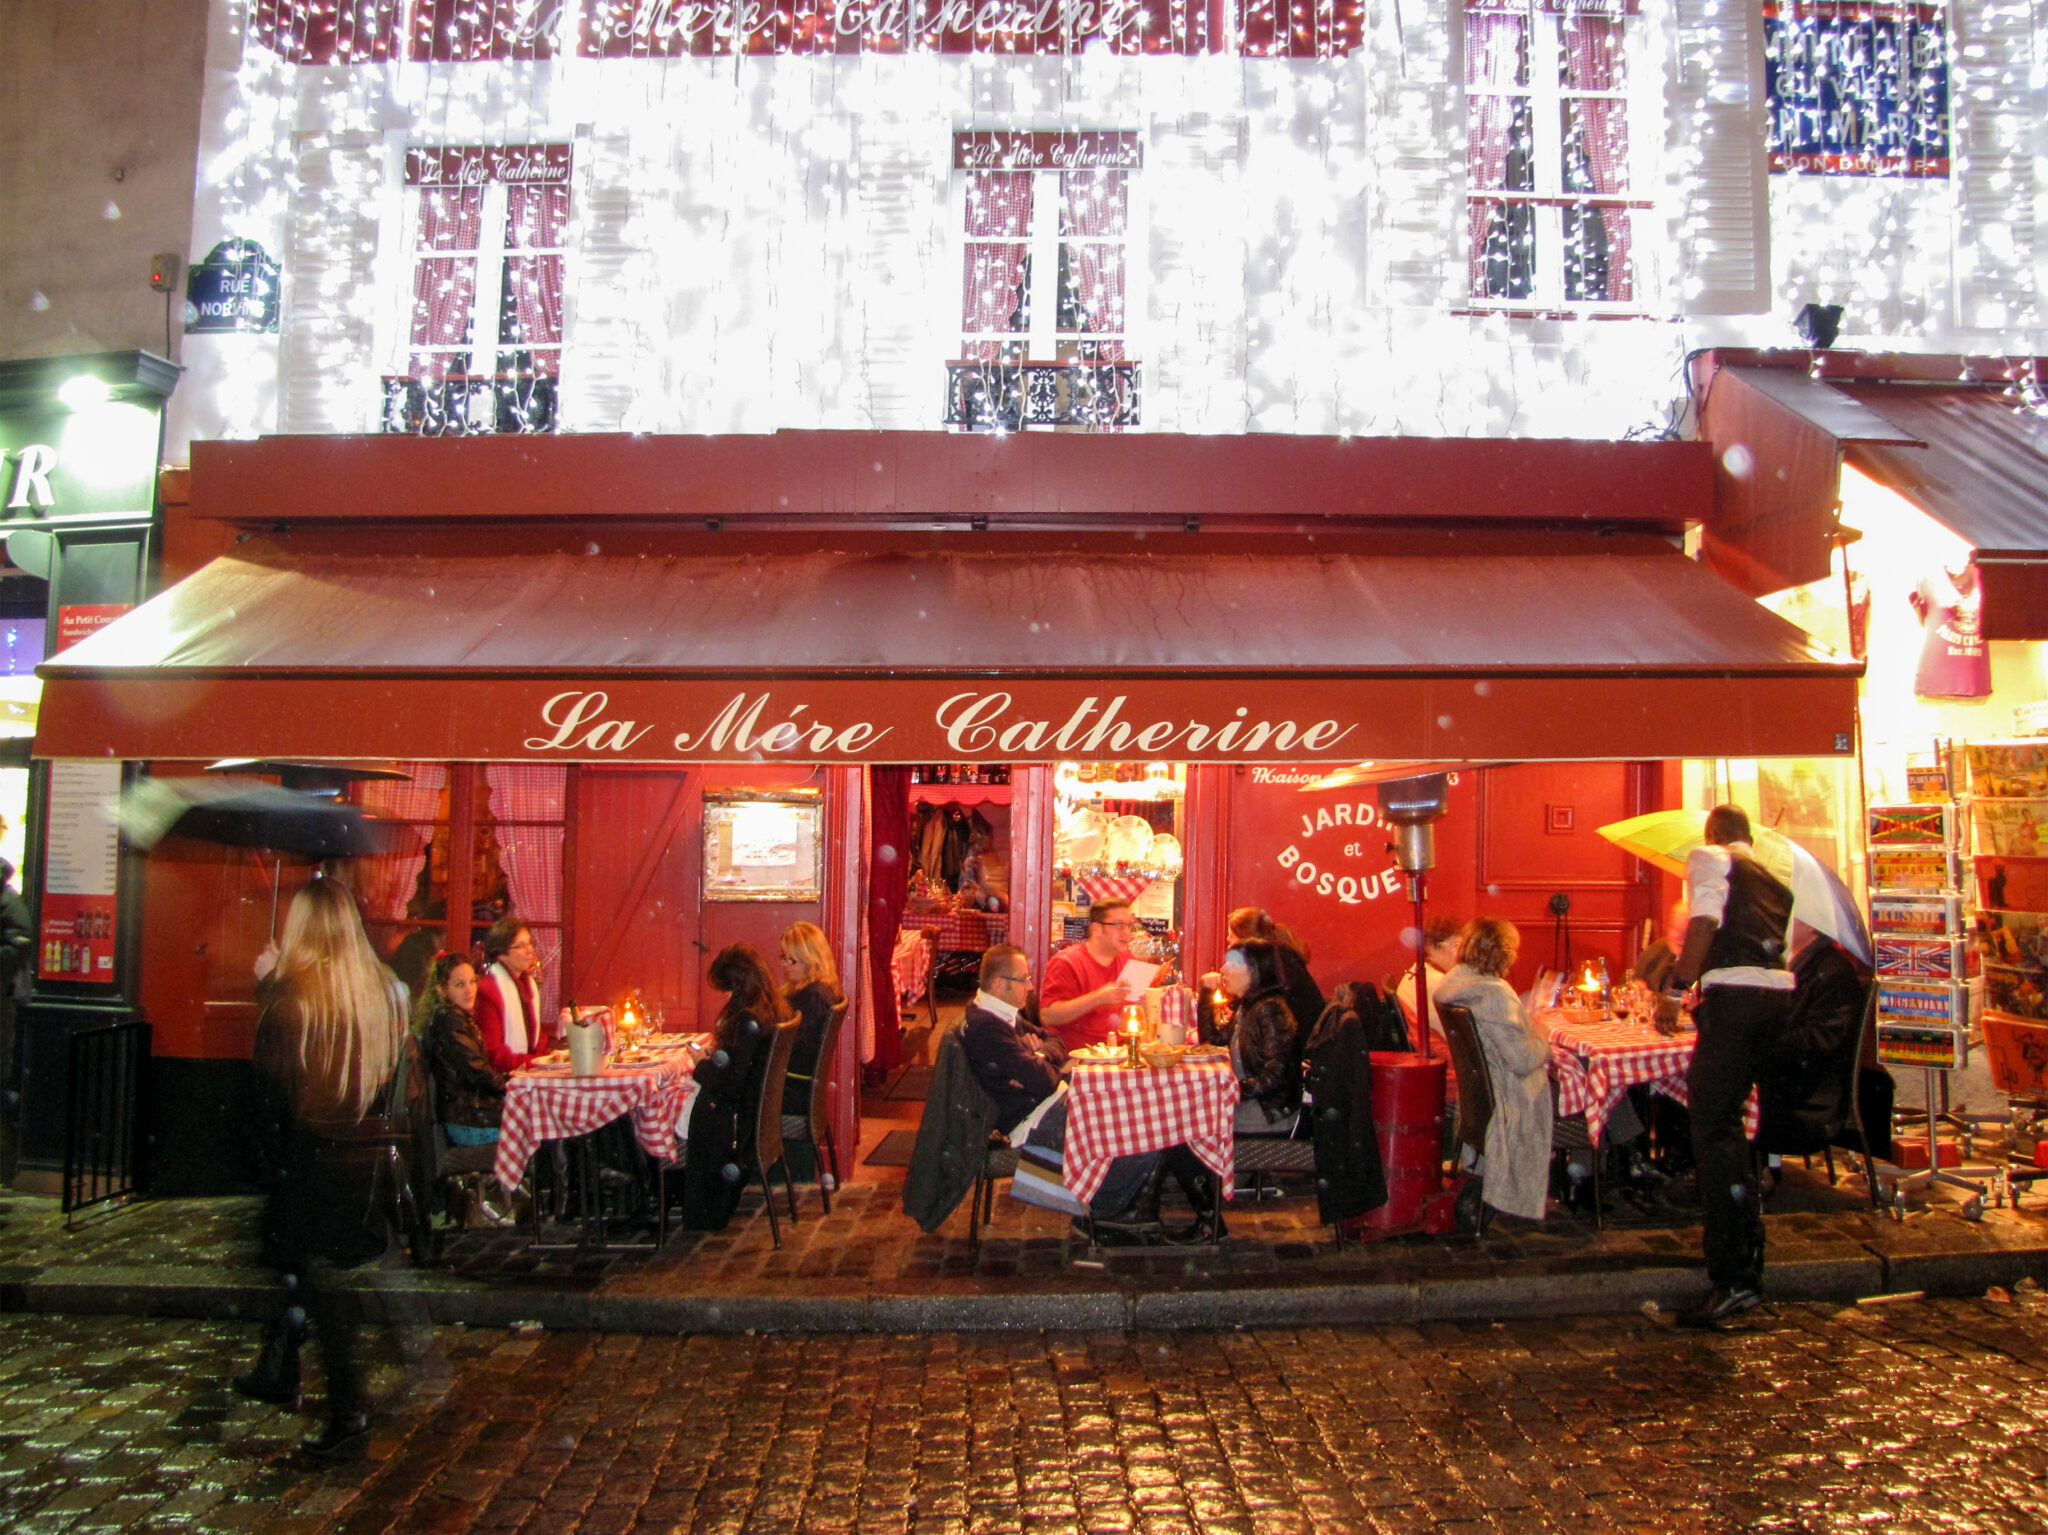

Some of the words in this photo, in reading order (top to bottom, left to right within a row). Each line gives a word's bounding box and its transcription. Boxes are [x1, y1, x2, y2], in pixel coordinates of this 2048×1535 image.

[834, 0, 1147, 35] Caherine
[220, 280, 249, 293] RUE
[0, 444, 57, 508] R
[524, 691, 655, 751] La
[935, 691, 1359, 753] Catherine
[1252, 766, 1322, 784] Maison
[1343, 841, 1363, 857] et
[1276, 845, 1402, 904] BOSQUE
[1878, 909, 1940, 923] RUSSIE
